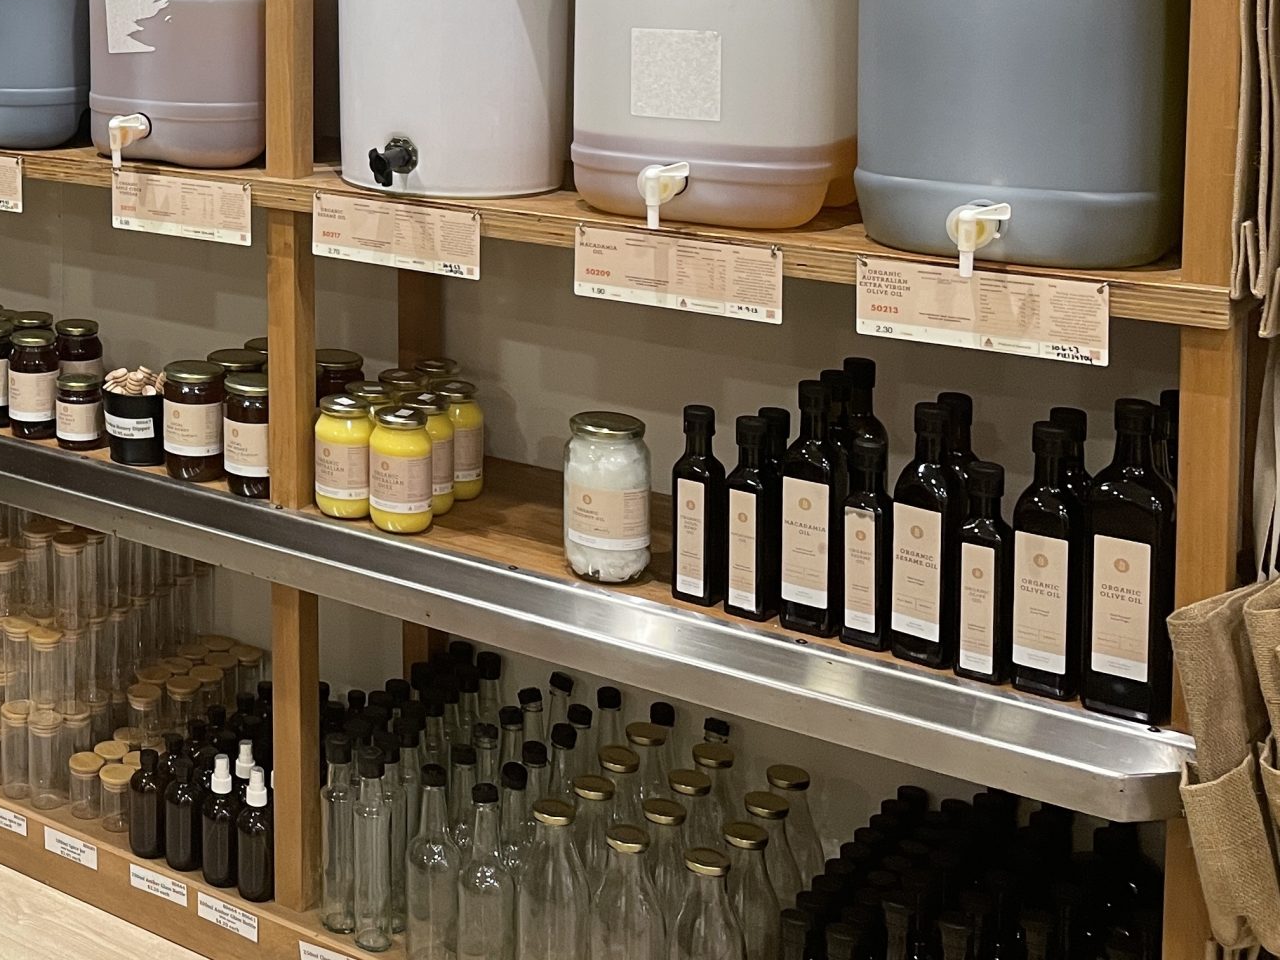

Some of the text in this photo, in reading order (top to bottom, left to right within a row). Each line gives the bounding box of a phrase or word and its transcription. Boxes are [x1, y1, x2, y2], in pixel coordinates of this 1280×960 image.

[322, 230, 341, 239] 50217
[579, 241, 618, 251] MACADAMIA
[585, 268, 611, 278] 50209
[866, 268, 902, 278] ORGANIC
[861, 274, 908, 285] AUSTRALIAN
[884, 283, 911, 292] VIRGIN
[870, 304, 899, 314] 50213
[875, 325, 893, 334] 2.30
[784, 519, 826, 533] MACADAMIA
[899, 547, 934, 562] ORGANIC
[895, 554, 938, 570] SESAME OIL
[1021, 578, 1060, 592] ORGANIC
[1101, 583, 1141, 597] ORGANIC
[1020, 584, 1061, 599] OLIVE OIL
[1100, 591, 1143, 605] OLIVE OIL
